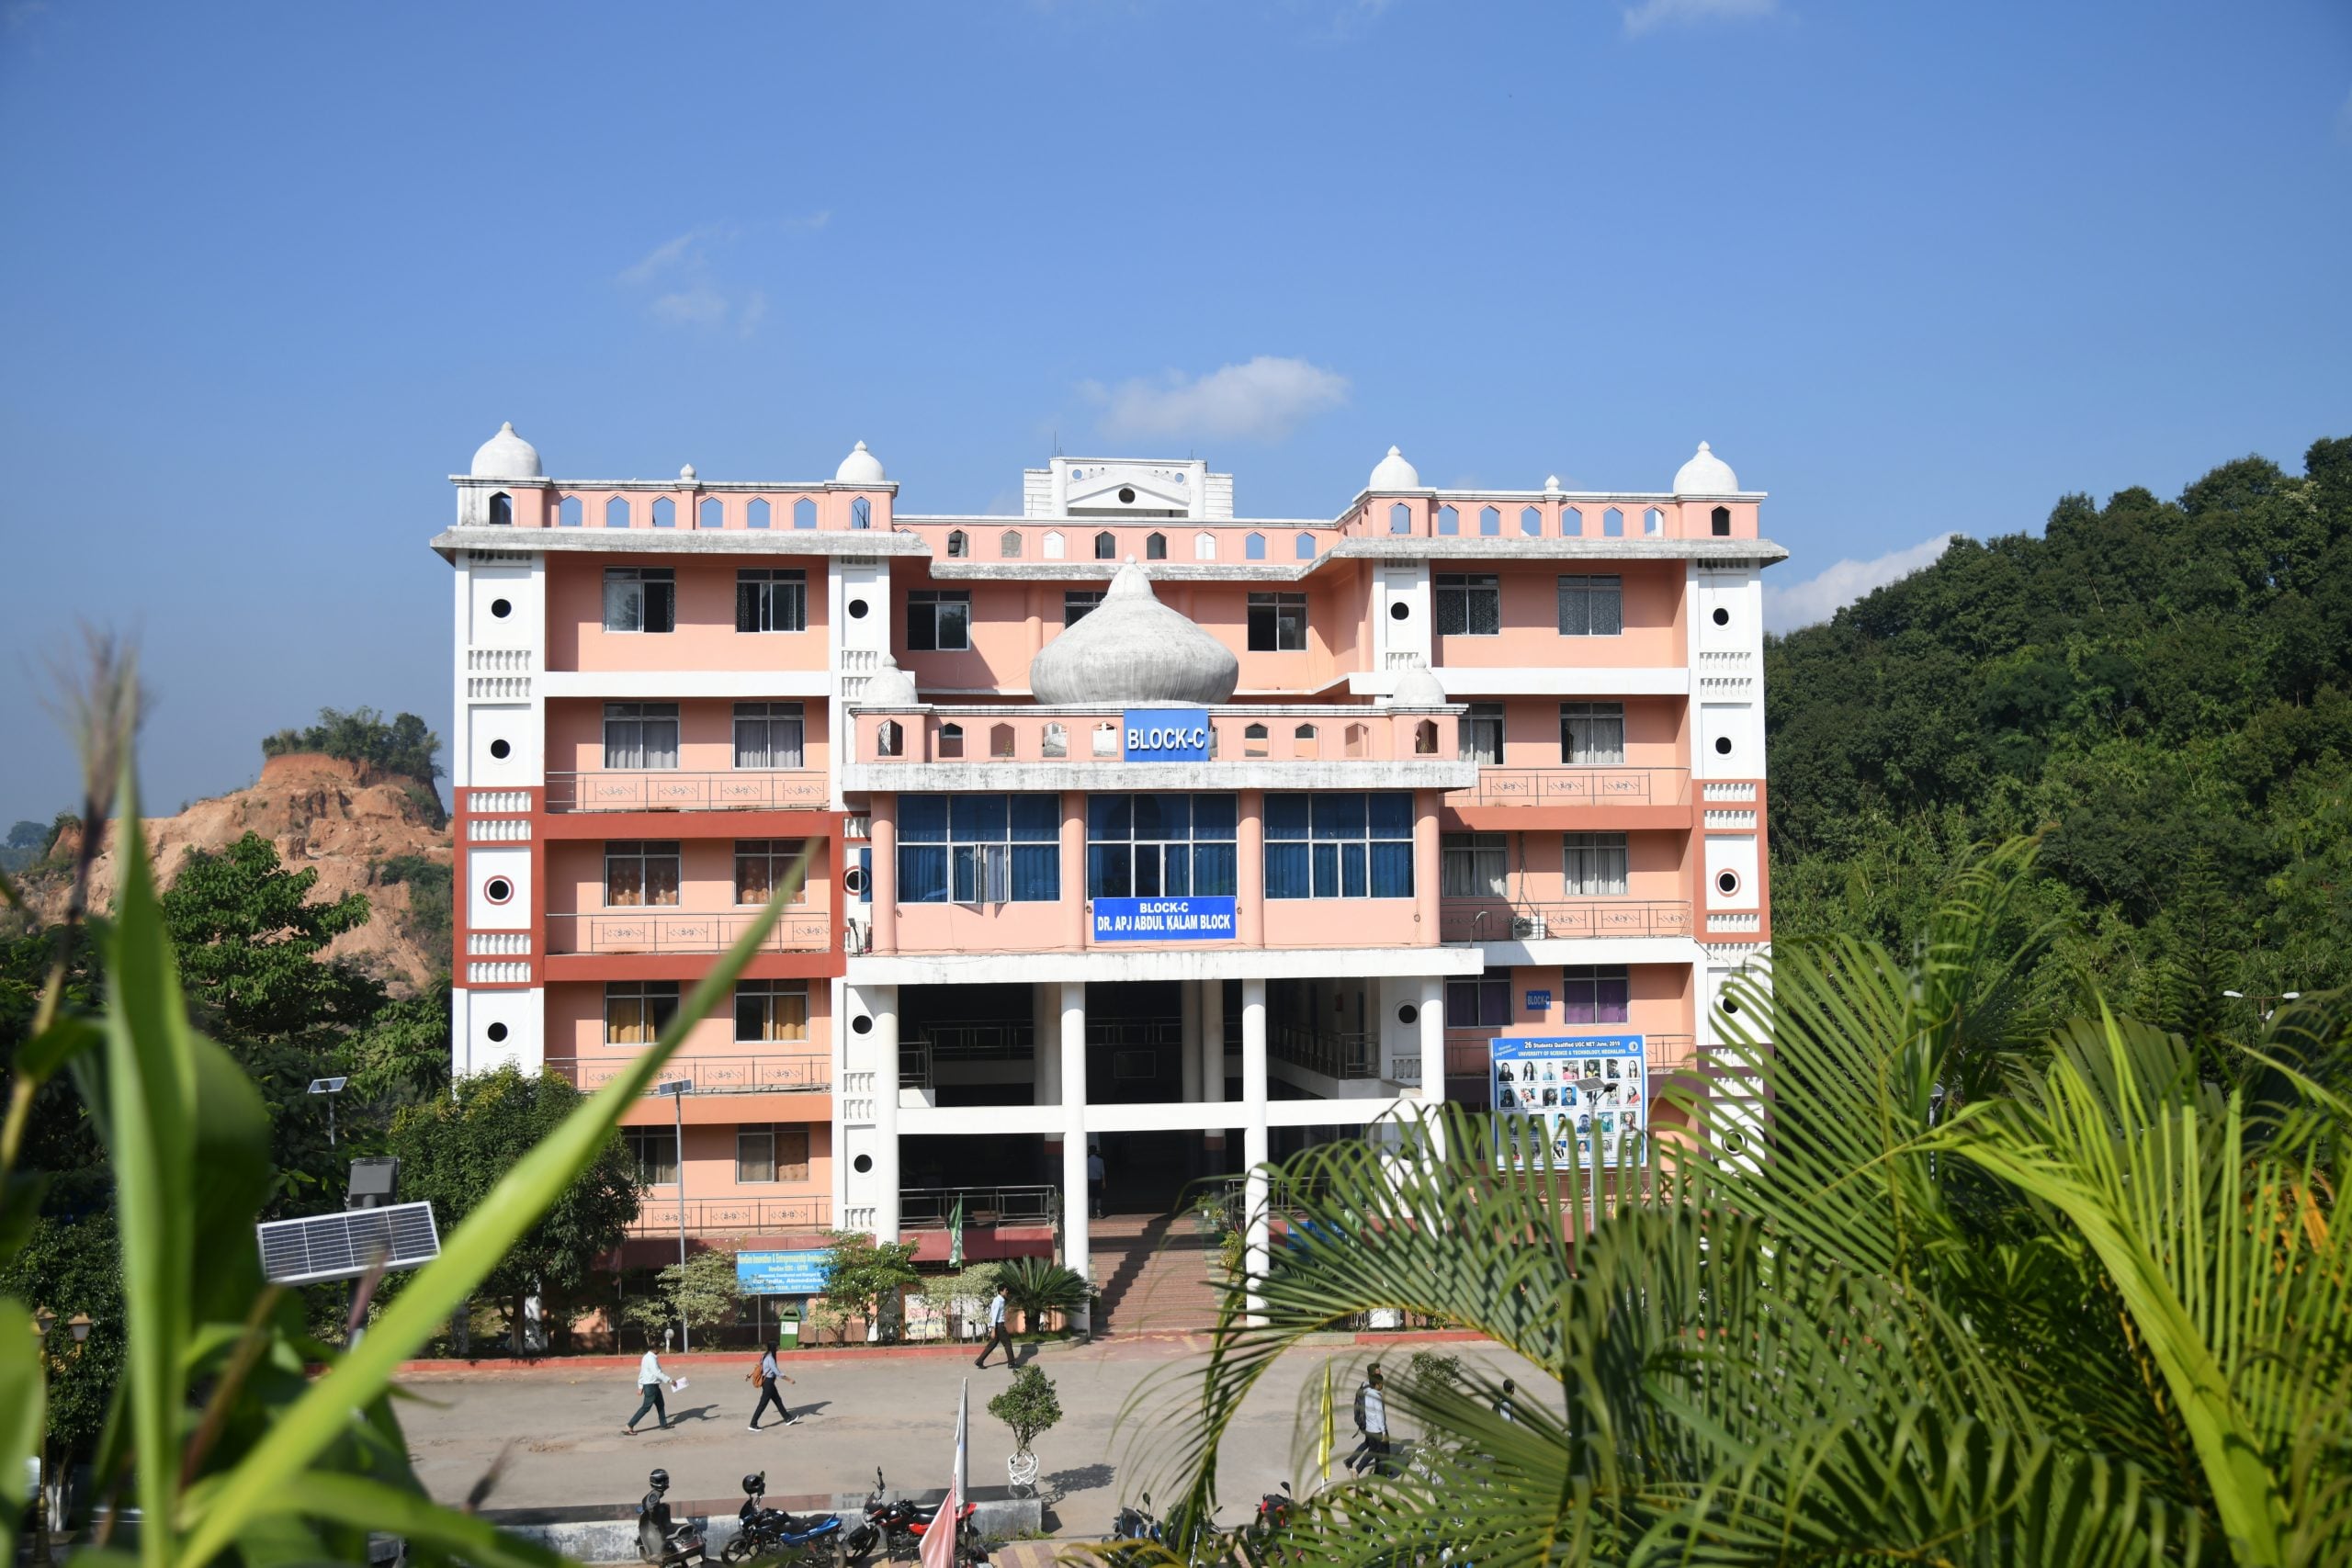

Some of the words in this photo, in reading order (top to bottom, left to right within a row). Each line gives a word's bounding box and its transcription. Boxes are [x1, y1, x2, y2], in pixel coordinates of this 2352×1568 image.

[1127, 728, 1205, 750] BLOCK-C
[1139, 902, 1189, 913] BLOCK-C
[1097, 916, 1113, 931] DR.
[1114, 916, 1132, 931] APJ
[1134, 915, 1165, 931] ABDUL
[1167, 915, 1198, 930] KALAM
[1200, 914, 1231, 930] BLOCK
[1527, 995, 1550, 1005] BLOCK-C
[1524, 1041, 1532, 1049] 26
